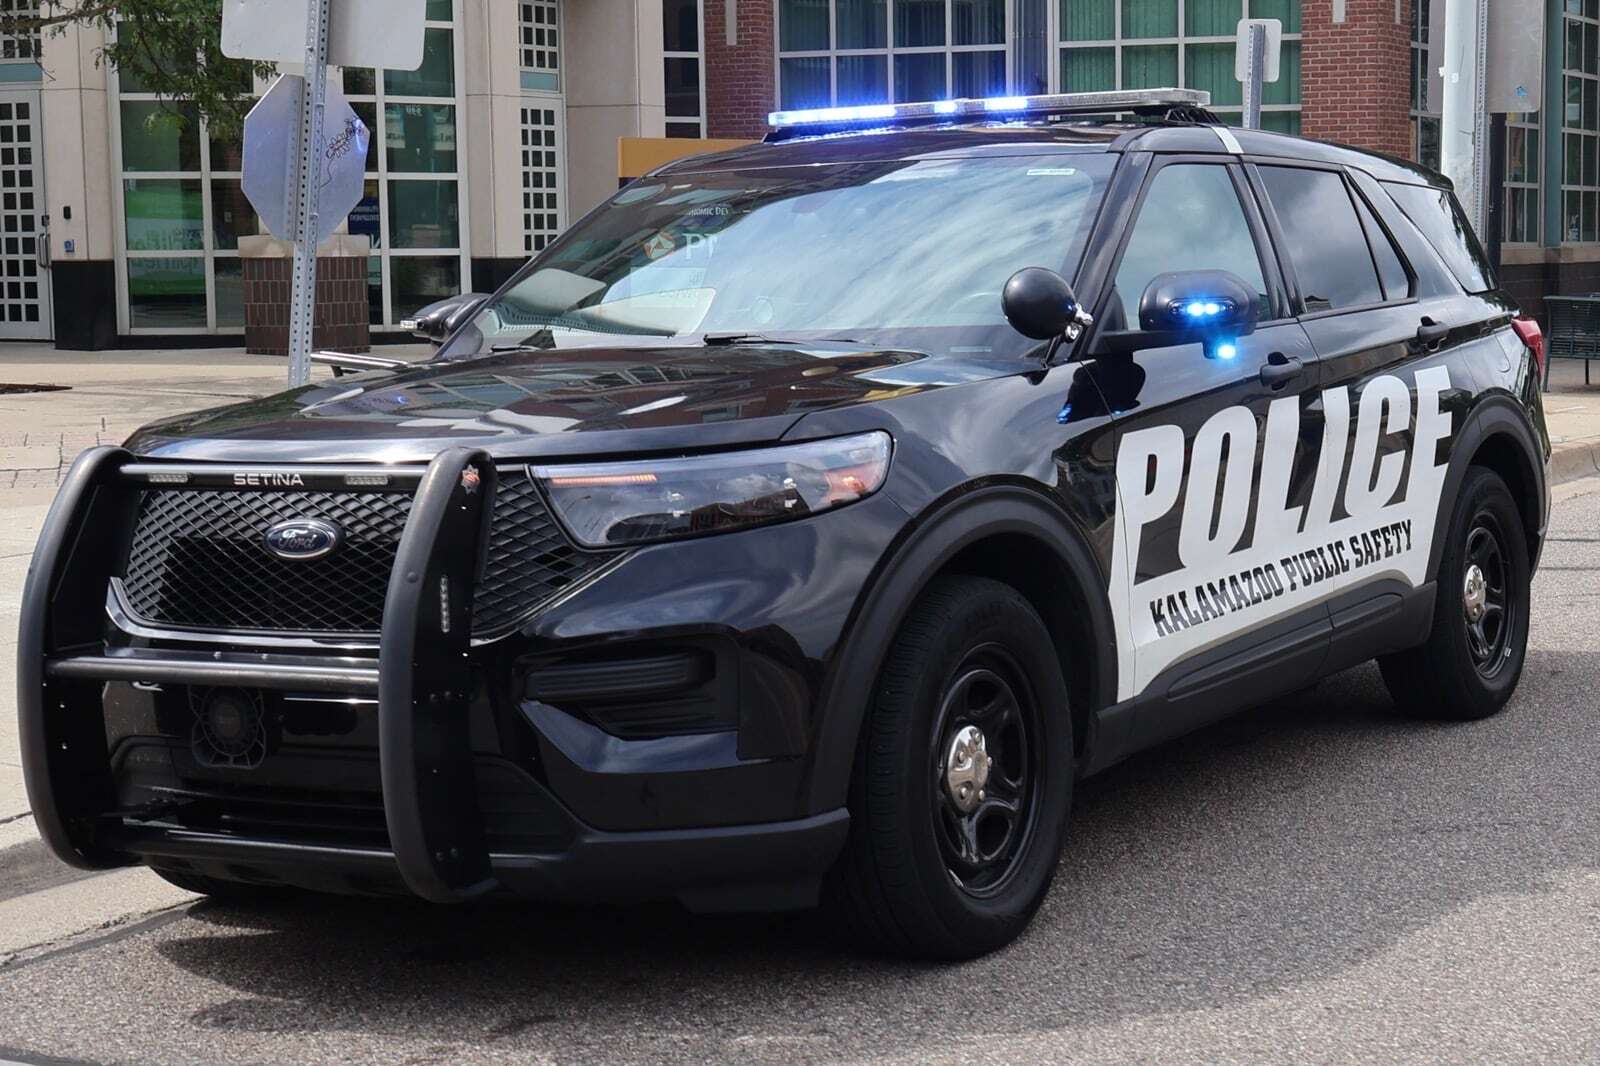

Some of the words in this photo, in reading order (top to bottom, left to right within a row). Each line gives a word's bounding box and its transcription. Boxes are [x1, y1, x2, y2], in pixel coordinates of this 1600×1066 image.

[233, 473, 304, 486] SETINA
[1113, 365, 1452, 586] POLICE
[279, 528, 318, 550] Ford
[1149, 562, 1285, 637] KALAMAZOO
[1280, 540, 1350, 591] PUBLIC
[1349, 519, 1412, 568] SAFETY
